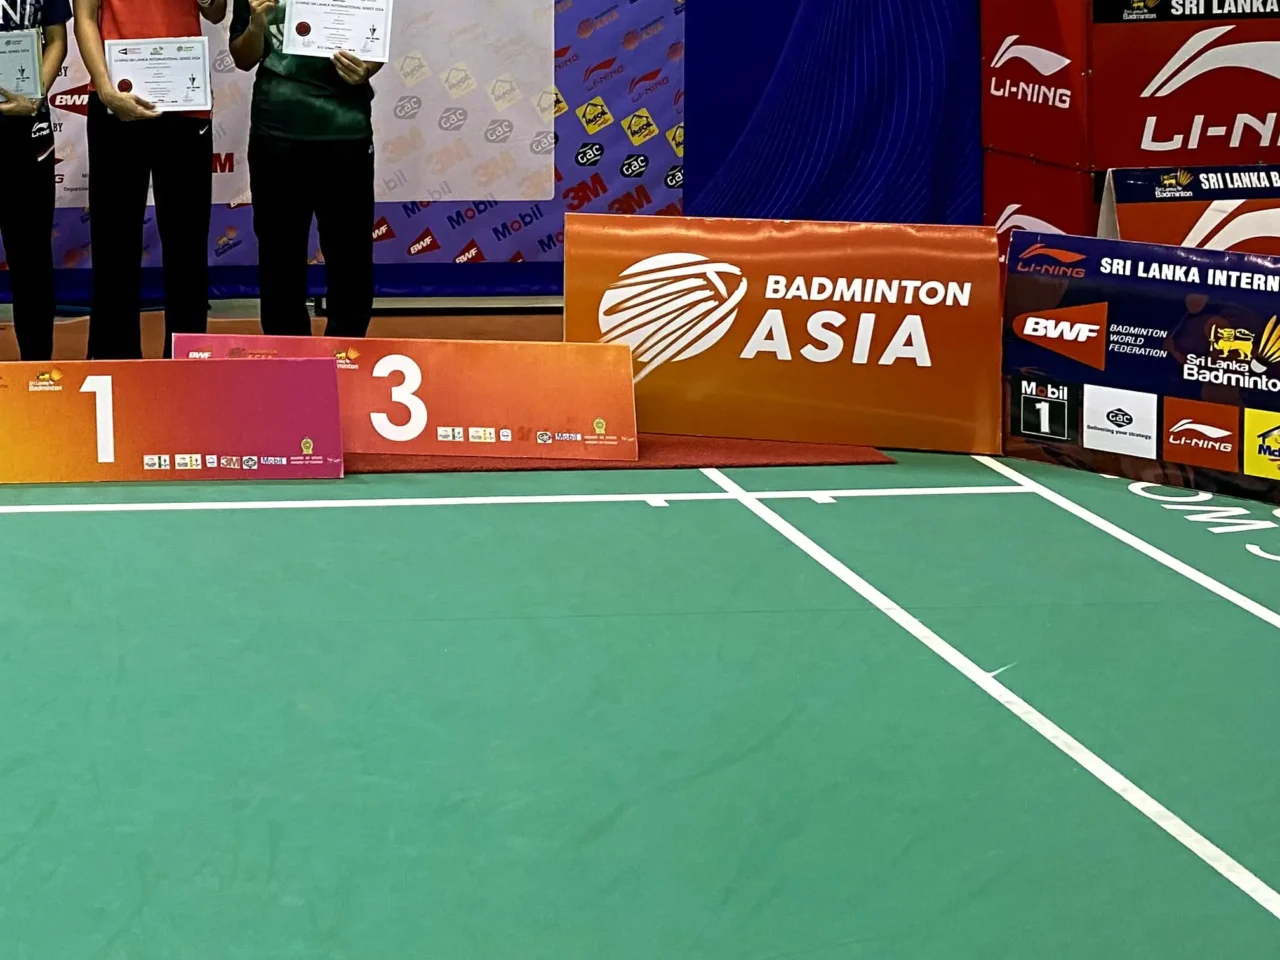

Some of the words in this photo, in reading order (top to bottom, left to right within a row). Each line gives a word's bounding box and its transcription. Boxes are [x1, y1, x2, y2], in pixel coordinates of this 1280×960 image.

[990, 76, 1071, 109] LI-NING
[213, 153, 234, 173] M
[1199, 172, 1224, 190] SRI
[1224, 171, 1270, 189] LANKA
[562, 172, 608, 211] 3M
[1155, 190, 1193, 198] Badminton
[492, 203, 544, 241] Mobil
[410, 235, 433, 254] BWF
[1017, 262, 1085, 278] LI-NING
[1101, 257, 1131, 277] SRI
[1137, 260, 1200, 284] LANKA
[765, 275, 972, 307] BADMINTON
[740, 309, 932, 367] ASIA
[1023, 316, 1100, 342] BWF
[1110, 324, 1167, 339] BADMINTON
[1109, 335, 1144, 345] WORLD
[1109, 343, 1167, 358] FEDERATION
[334, 362, 359, 370] minton
[1187, 354, 1206, 367] Sri
[1208, 356, 1249, 373] Lanka
[370, 354, 428, 442] 3
[1021, 380, 1068, 400] Mobil
[79, 375, 114, 463] 1
[1035, 401, 1050, 433] 1
[557, 433, 578, 441] Mobil
[1087, 424, 1114, 435] Delivering
[1115, 429, 1128, 437] your
[1169, 435, 1232, 452] LI-NING
[221, 457, 240, 468] 3M
[262, 457, 283, 465] Mobil
